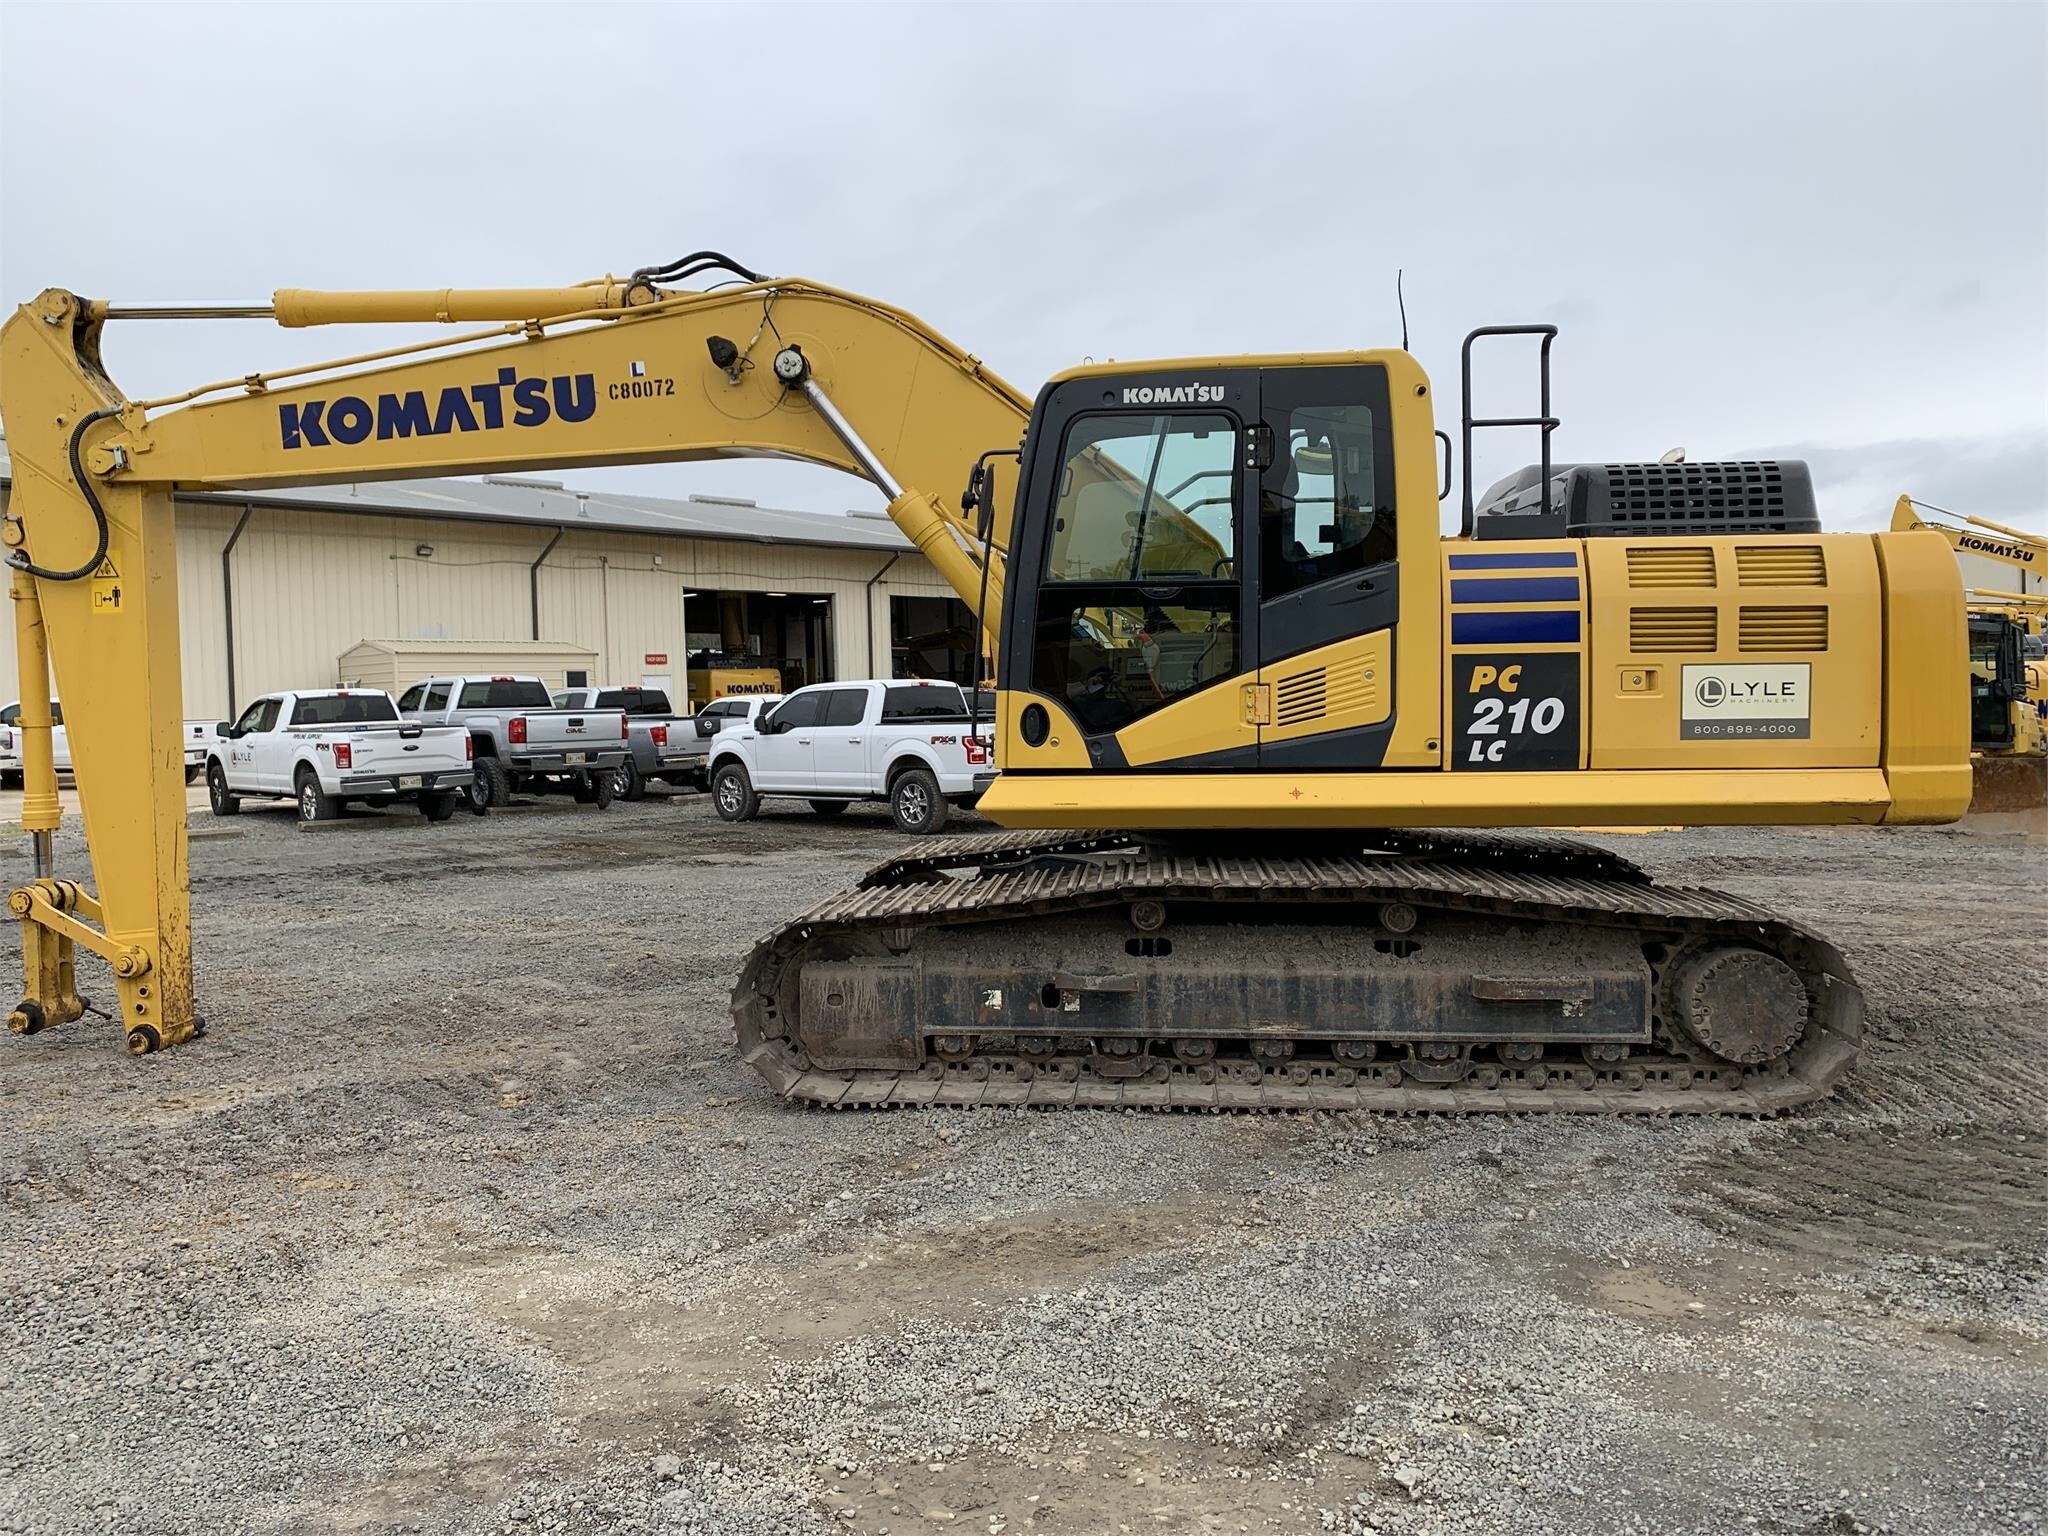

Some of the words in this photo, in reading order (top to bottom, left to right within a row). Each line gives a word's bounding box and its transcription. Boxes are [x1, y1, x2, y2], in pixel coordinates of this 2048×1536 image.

[609, 378, 675, 400] C80072
[1123, 382, 1225, 404] KOMATSU
[279, 366, 597, 450] KOMATSU
[1959, 536, 2035, 562] KOMATSU
[727, 682, 775, 694] KOMATSU
[1469, 665, 1522, 693] PC
[1731, 682, 1796, 696] LYLE
[1467, 697, 1565, 734] 210
[931, 735, 957, 745] FX4
[1694, 725, 1797, 734] 800-898-4000
[238, 752, 252, 762] LYLE
[316, 743, 330, 751] FX4
[1468, 740, 1507, 762] LC
